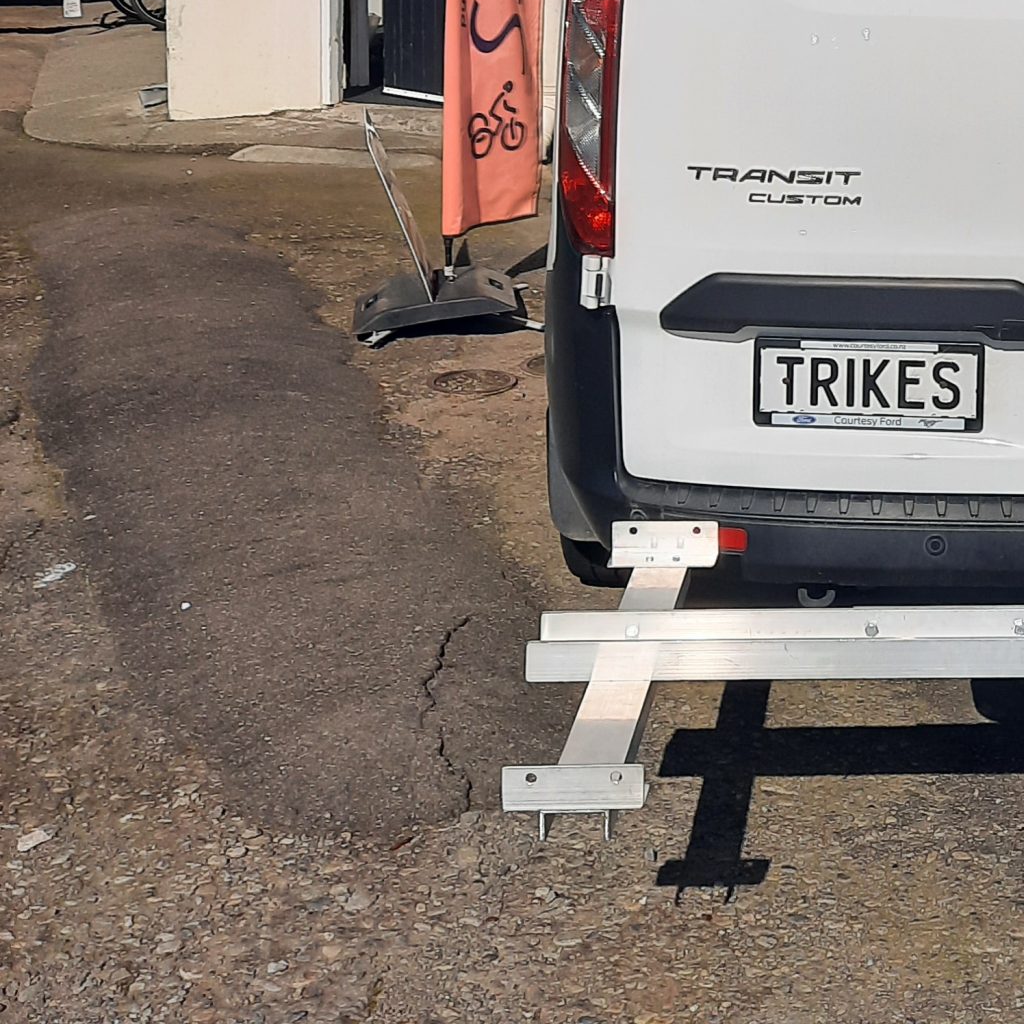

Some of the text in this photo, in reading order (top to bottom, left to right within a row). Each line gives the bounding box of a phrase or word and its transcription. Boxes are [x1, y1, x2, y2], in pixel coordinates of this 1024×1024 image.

[687, 165, 861, 185] TRANSIT
[748, 193, 861, 205] CUSTOM
[776, 355, 961, 410] TRIKES
[833, 415, 902, 426] Courtesy Ford
